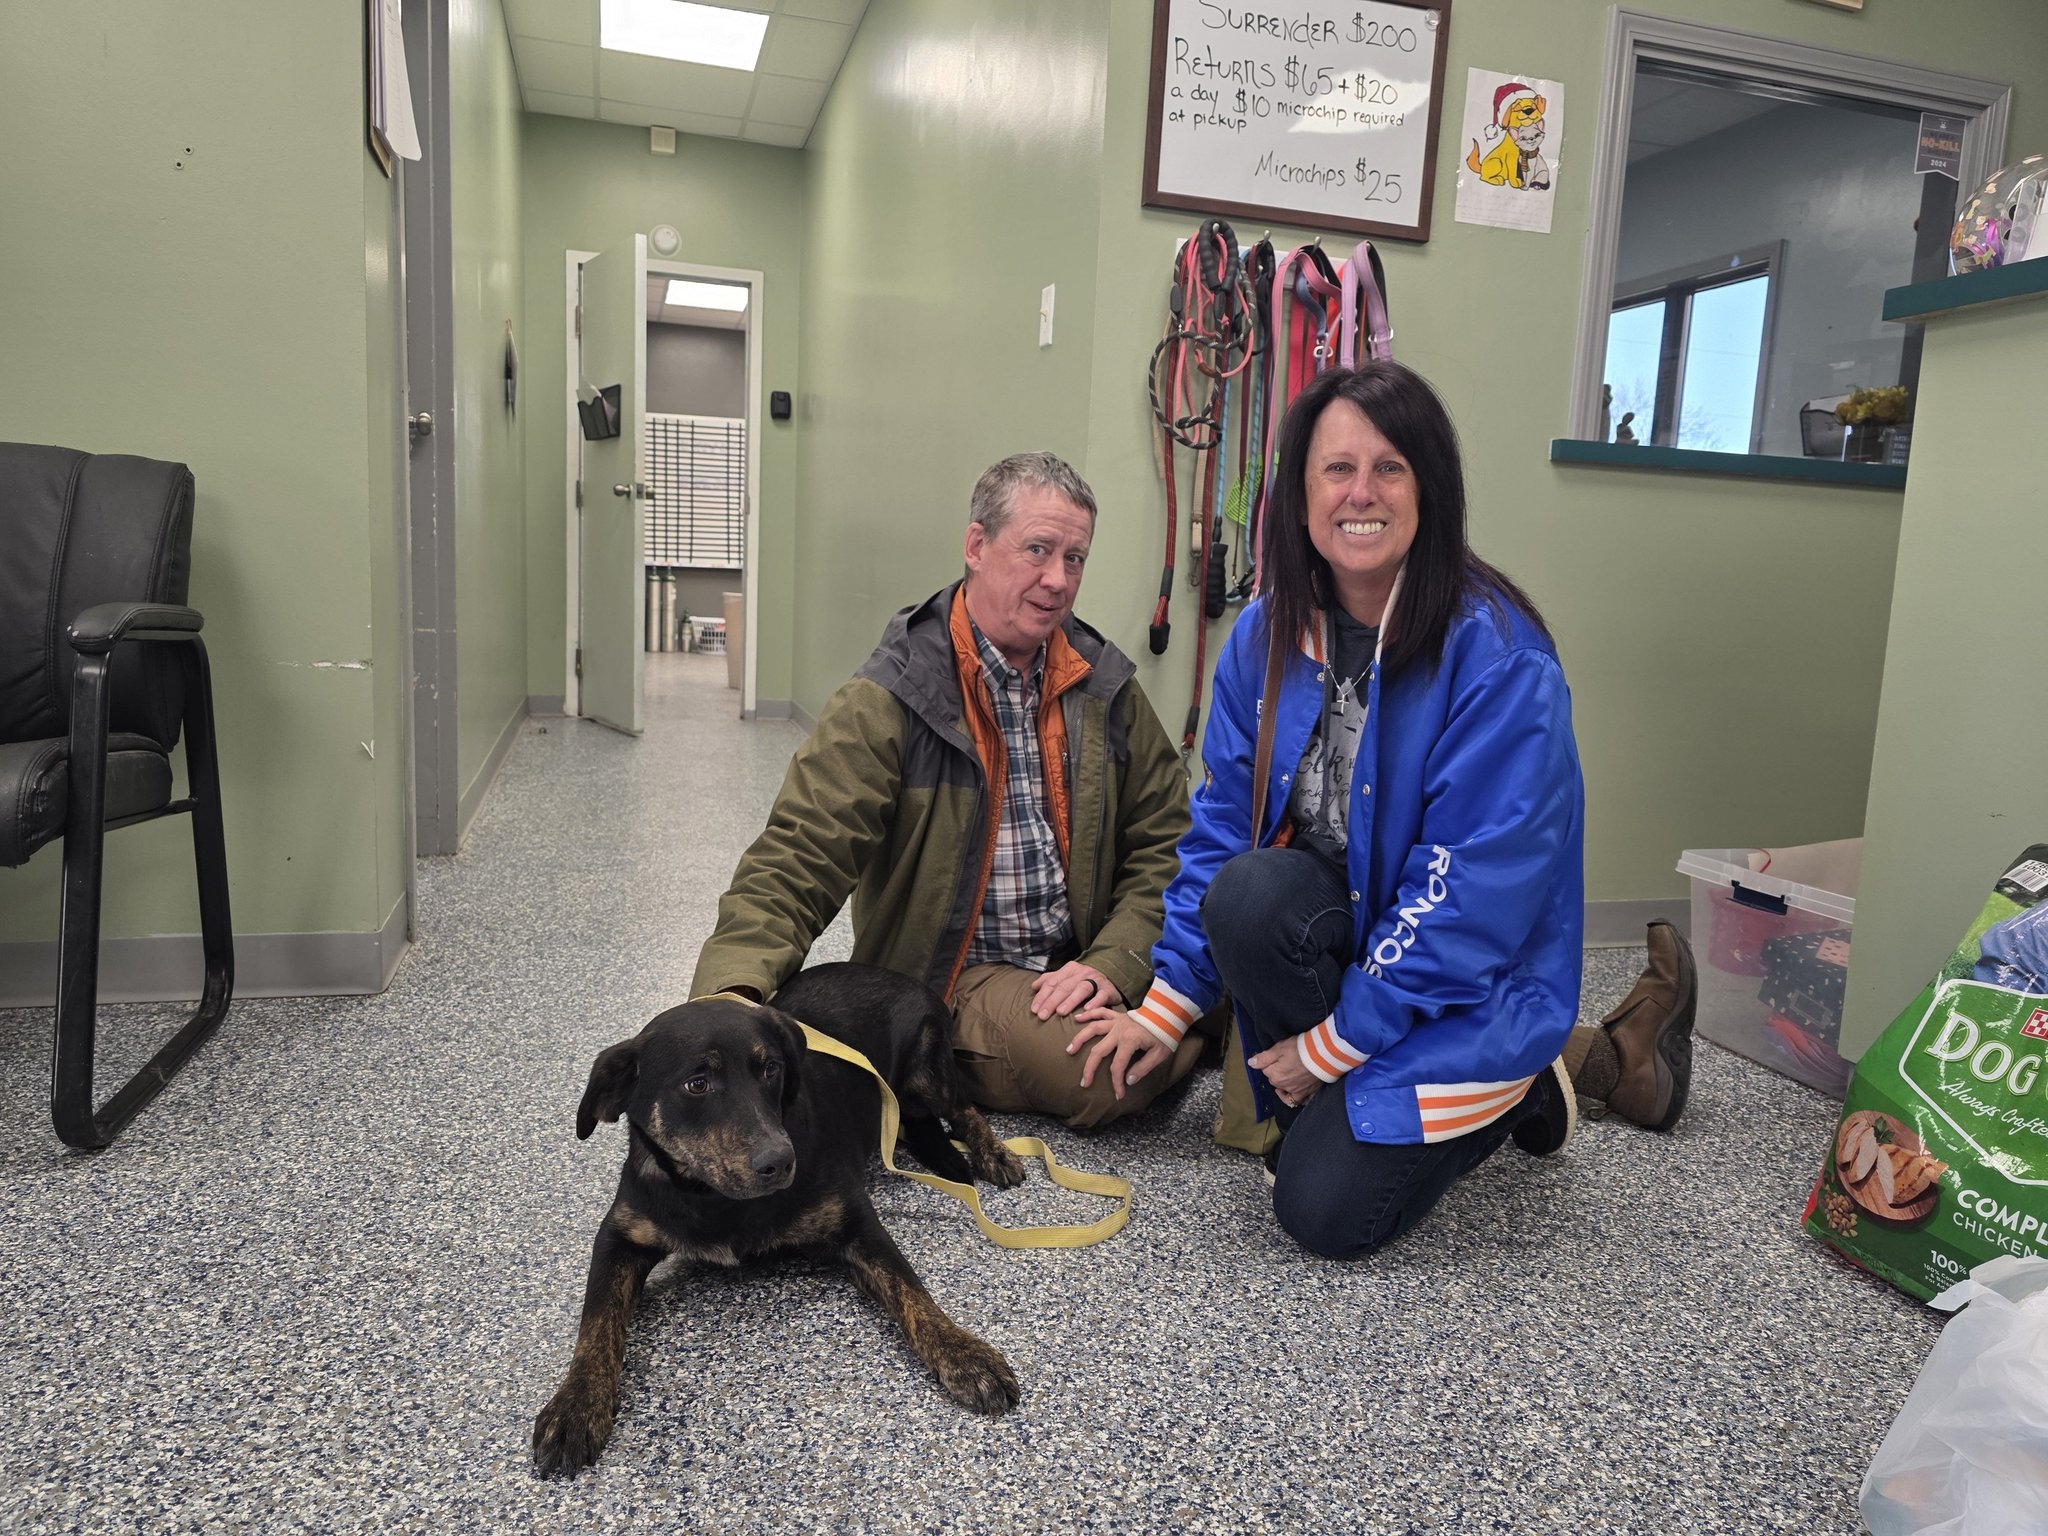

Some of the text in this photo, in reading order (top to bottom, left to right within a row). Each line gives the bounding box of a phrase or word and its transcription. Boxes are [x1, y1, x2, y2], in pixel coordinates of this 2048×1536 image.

[1345, 11, 1417, 53] $200
[1284, 54, 1335, 97] $65
[1338, 78, 1350, 94] +
[1353, 73, 1399, 105] $20
[1168, 109, 1248, 134] at pickup
[1170, 83, 1405, 130] a day $10 microchip required
[1255, 150, 1402, 204] Microchips $25
[1930, 159, 1947, 168] 2024
[1294, 782, 1338, 808] ocky
[2021, 864, 2048, 879] 1003
[1924, 1010, 2043, 1096] DOG
[1938, 1079, 2048, 1138] Always Crafte
[1953, 1211, 2038, 1258] CHICKEN
[1957, 1189, 2048, 1246] COMPL
[1931, 1250, 1967, 1275] 100%
